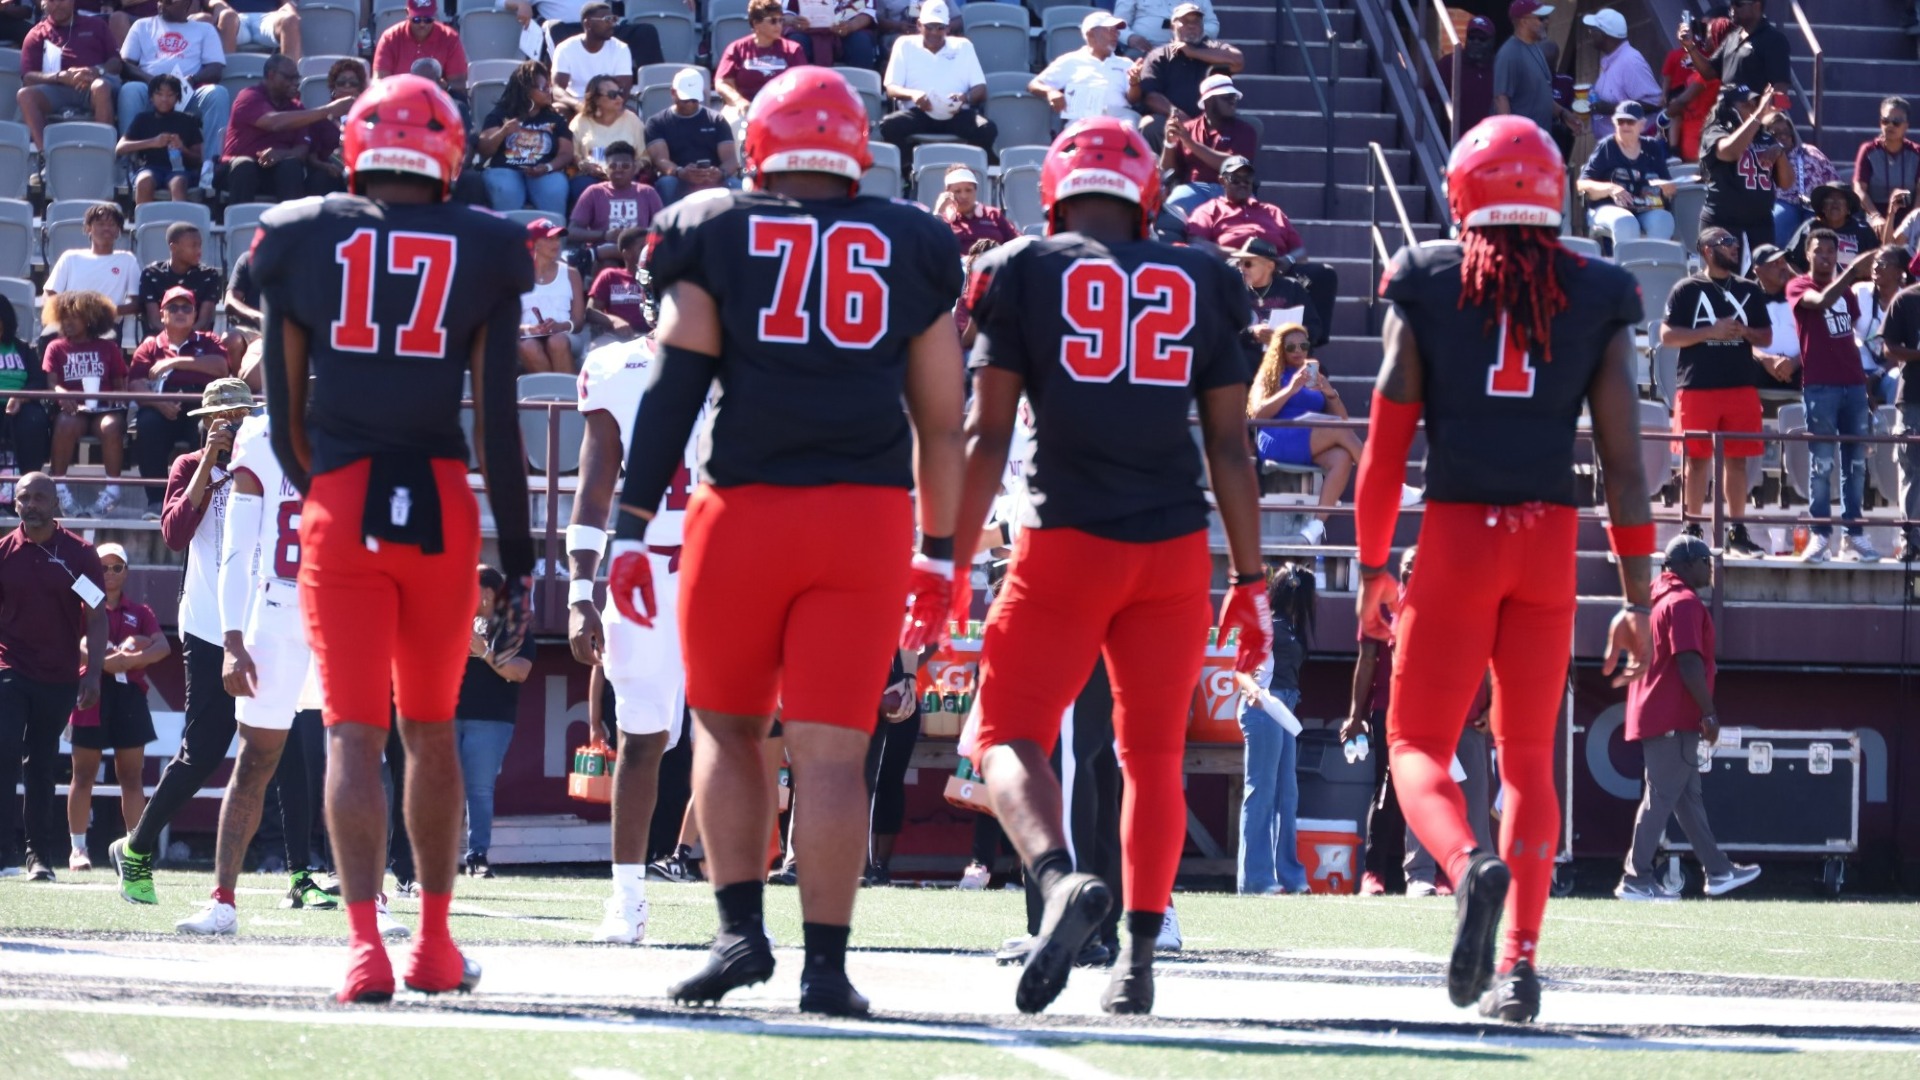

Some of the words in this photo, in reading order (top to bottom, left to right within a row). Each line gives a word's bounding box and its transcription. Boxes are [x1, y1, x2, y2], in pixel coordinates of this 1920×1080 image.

[371, 153, 427, 169] Riddell
[787, 155, 848, 173] Riddell
[1072, 174, 1126, 190] Riddell
[1490, 210, 1548, 224] Riddell
[748, 214, 892, 350] 76
[330, 227, 457, 359] 17
[1059, 257, 1197, 387] 92
[66, 351, 99, 365] NCCU
[1486, 307, 1536, 398] 1
[63, 362, 105, 379] EAGLES
[1209, 671, 1235, 697] G
